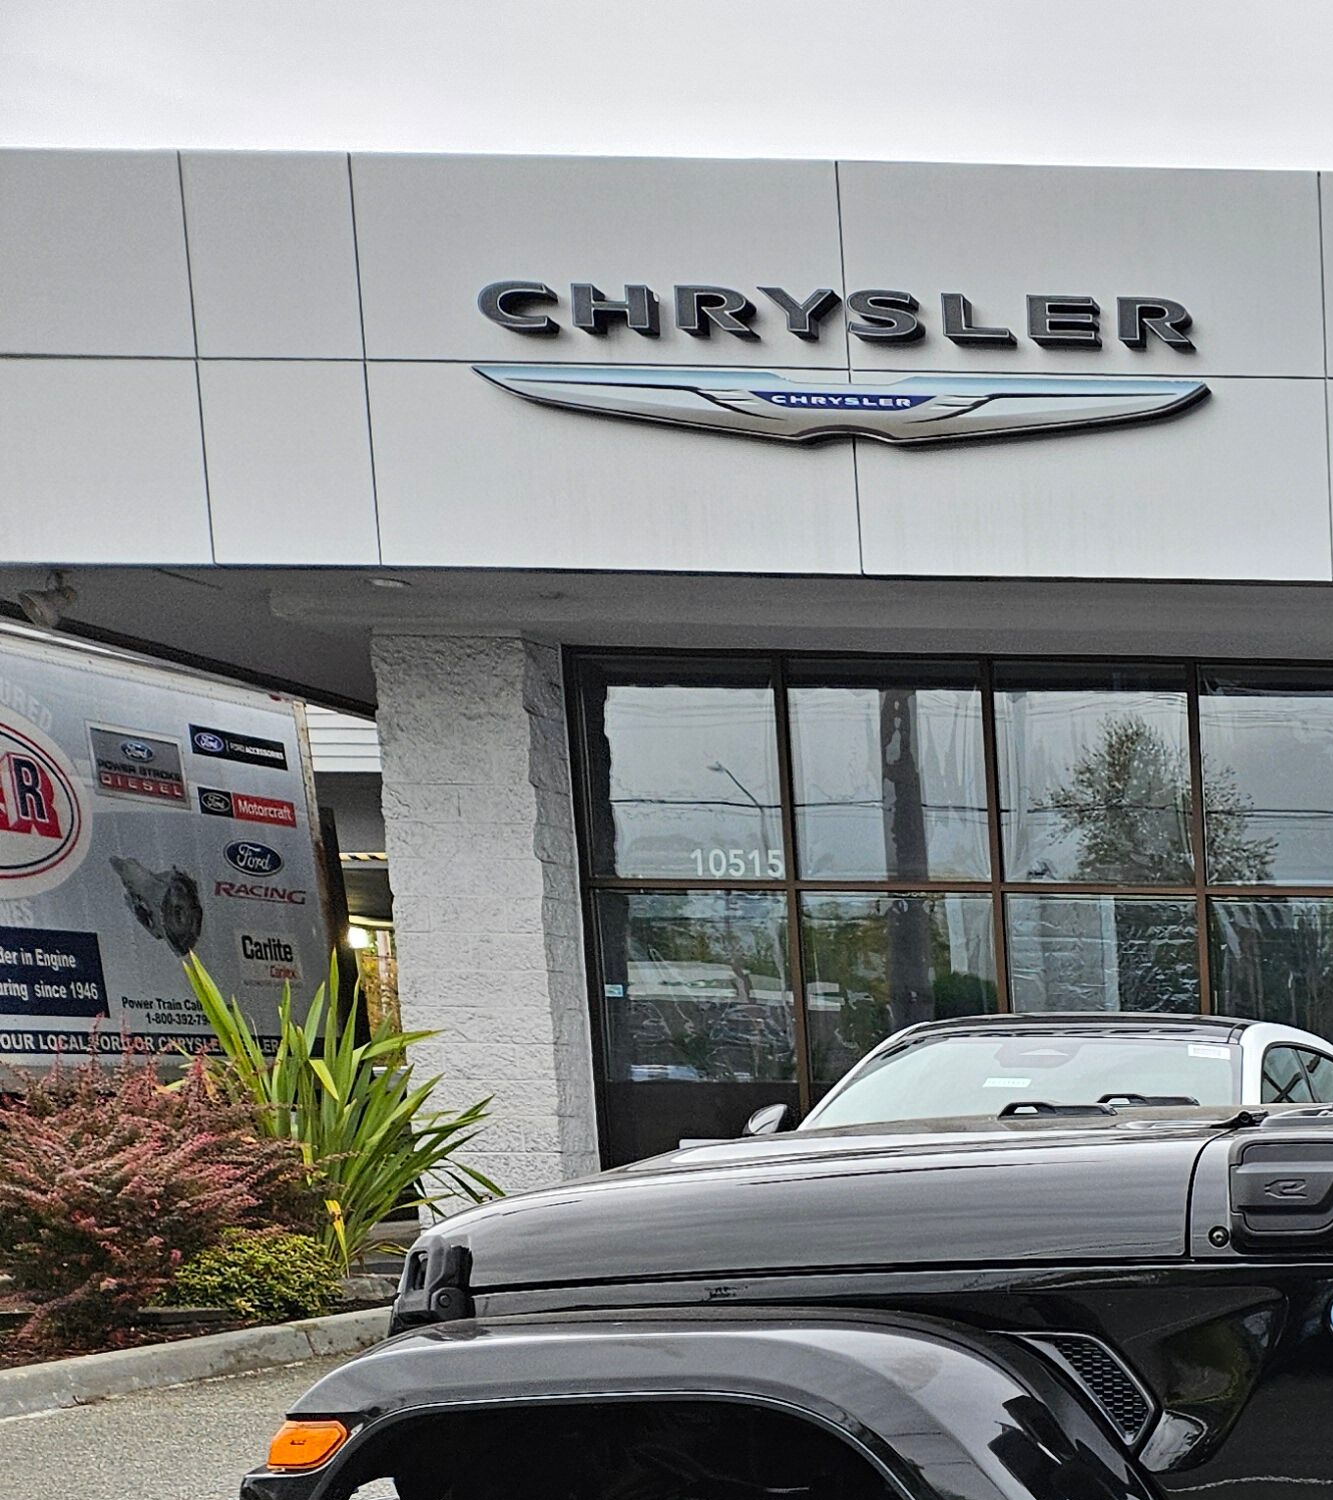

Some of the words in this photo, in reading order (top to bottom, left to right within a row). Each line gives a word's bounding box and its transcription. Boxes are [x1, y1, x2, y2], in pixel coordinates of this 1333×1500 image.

[477, 280, 1196, 352] CHRYSLER
[771, 395, 911, 407] CHRYSLER
[101, 773, 184, 796] DIESEL
[237, 799, 294, 821] Motorcraft
[690, 848, 785, 878] 10515
[214, 880, 307, 905] RACING
[20, 947, 34, 966] in
[35, 948, 77, 972] Engine
[241, 935, 294, 963] Carlite
[34, 980, 67, 999] since
[70, 981, 98, 1000] 1946
[121, 996, 153, 1010] Power
[155, 998, 182, 1010] Train
[146, 1012, 211, 1026] 1-800-392-79
[38, 1033, 86, 1052] LOCAL
